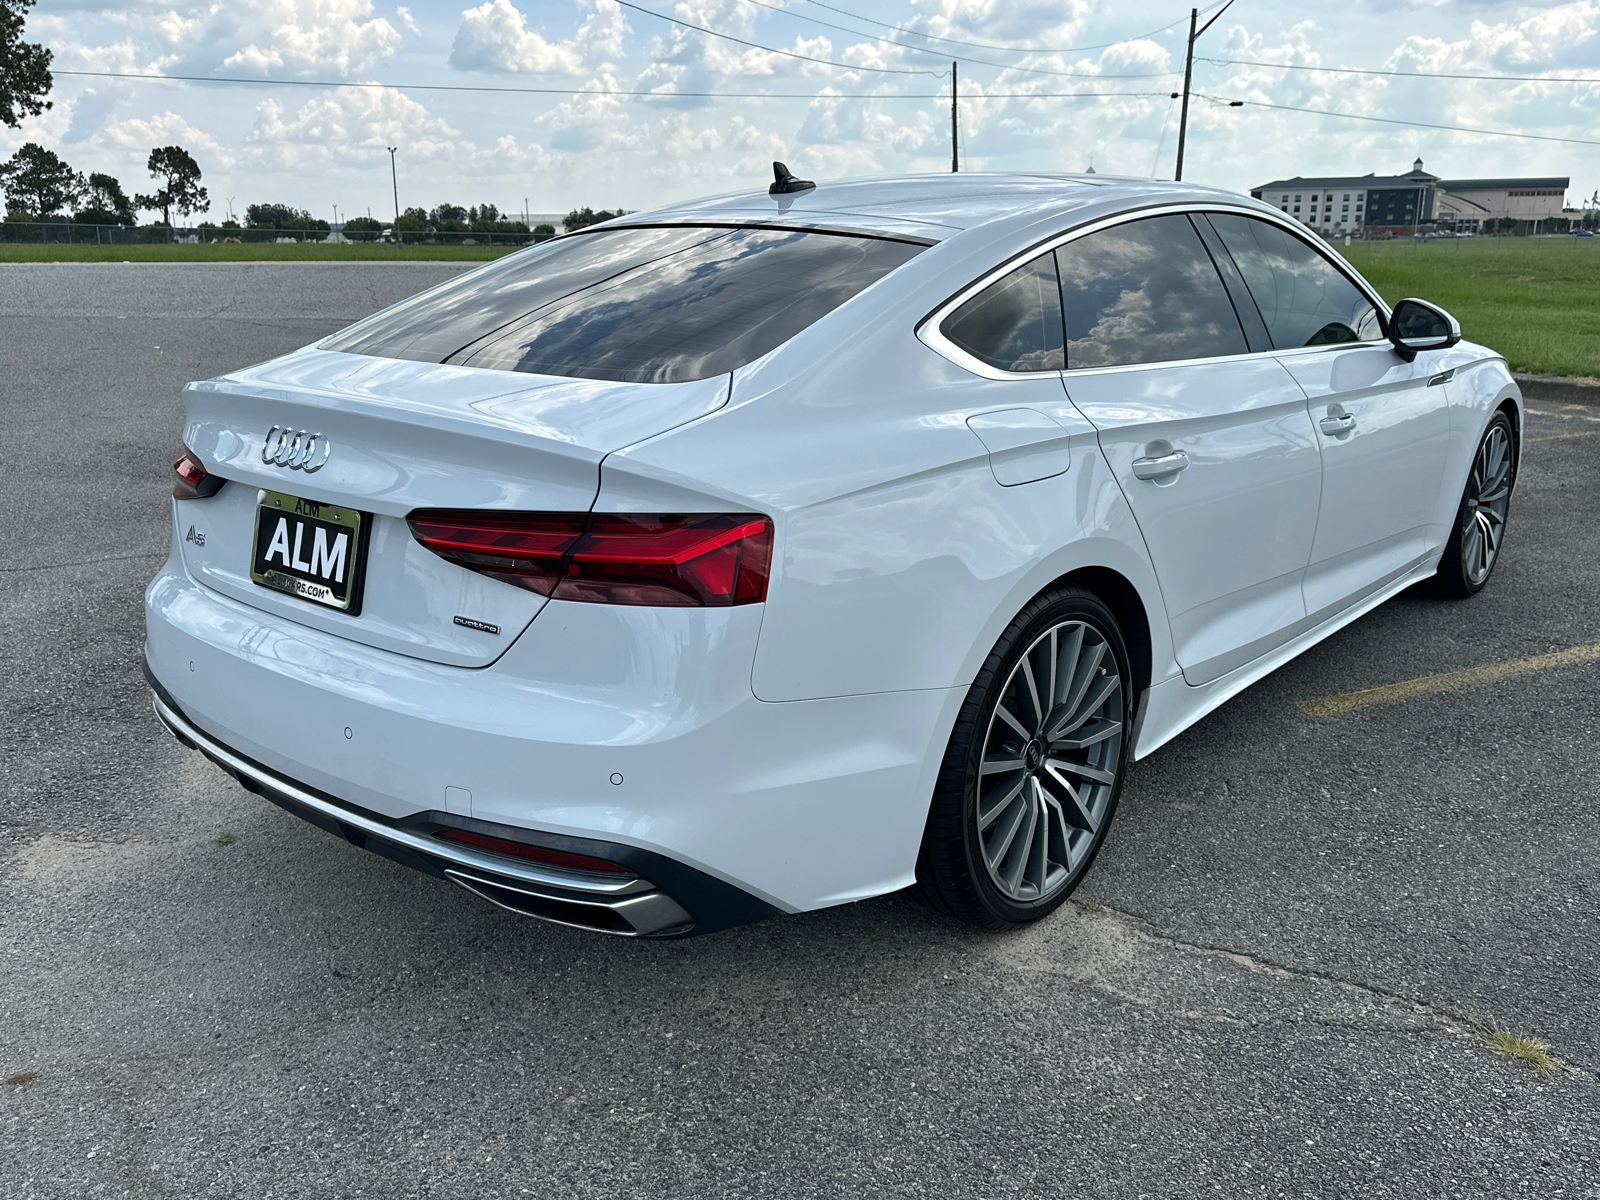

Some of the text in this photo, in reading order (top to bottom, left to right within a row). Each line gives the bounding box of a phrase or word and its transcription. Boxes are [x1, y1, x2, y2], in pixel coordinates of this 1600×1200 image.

[294, 498, 320, 518] ALM
[264, 516, 348, 583] ALM
[454, 616, 498, 633] quattro
